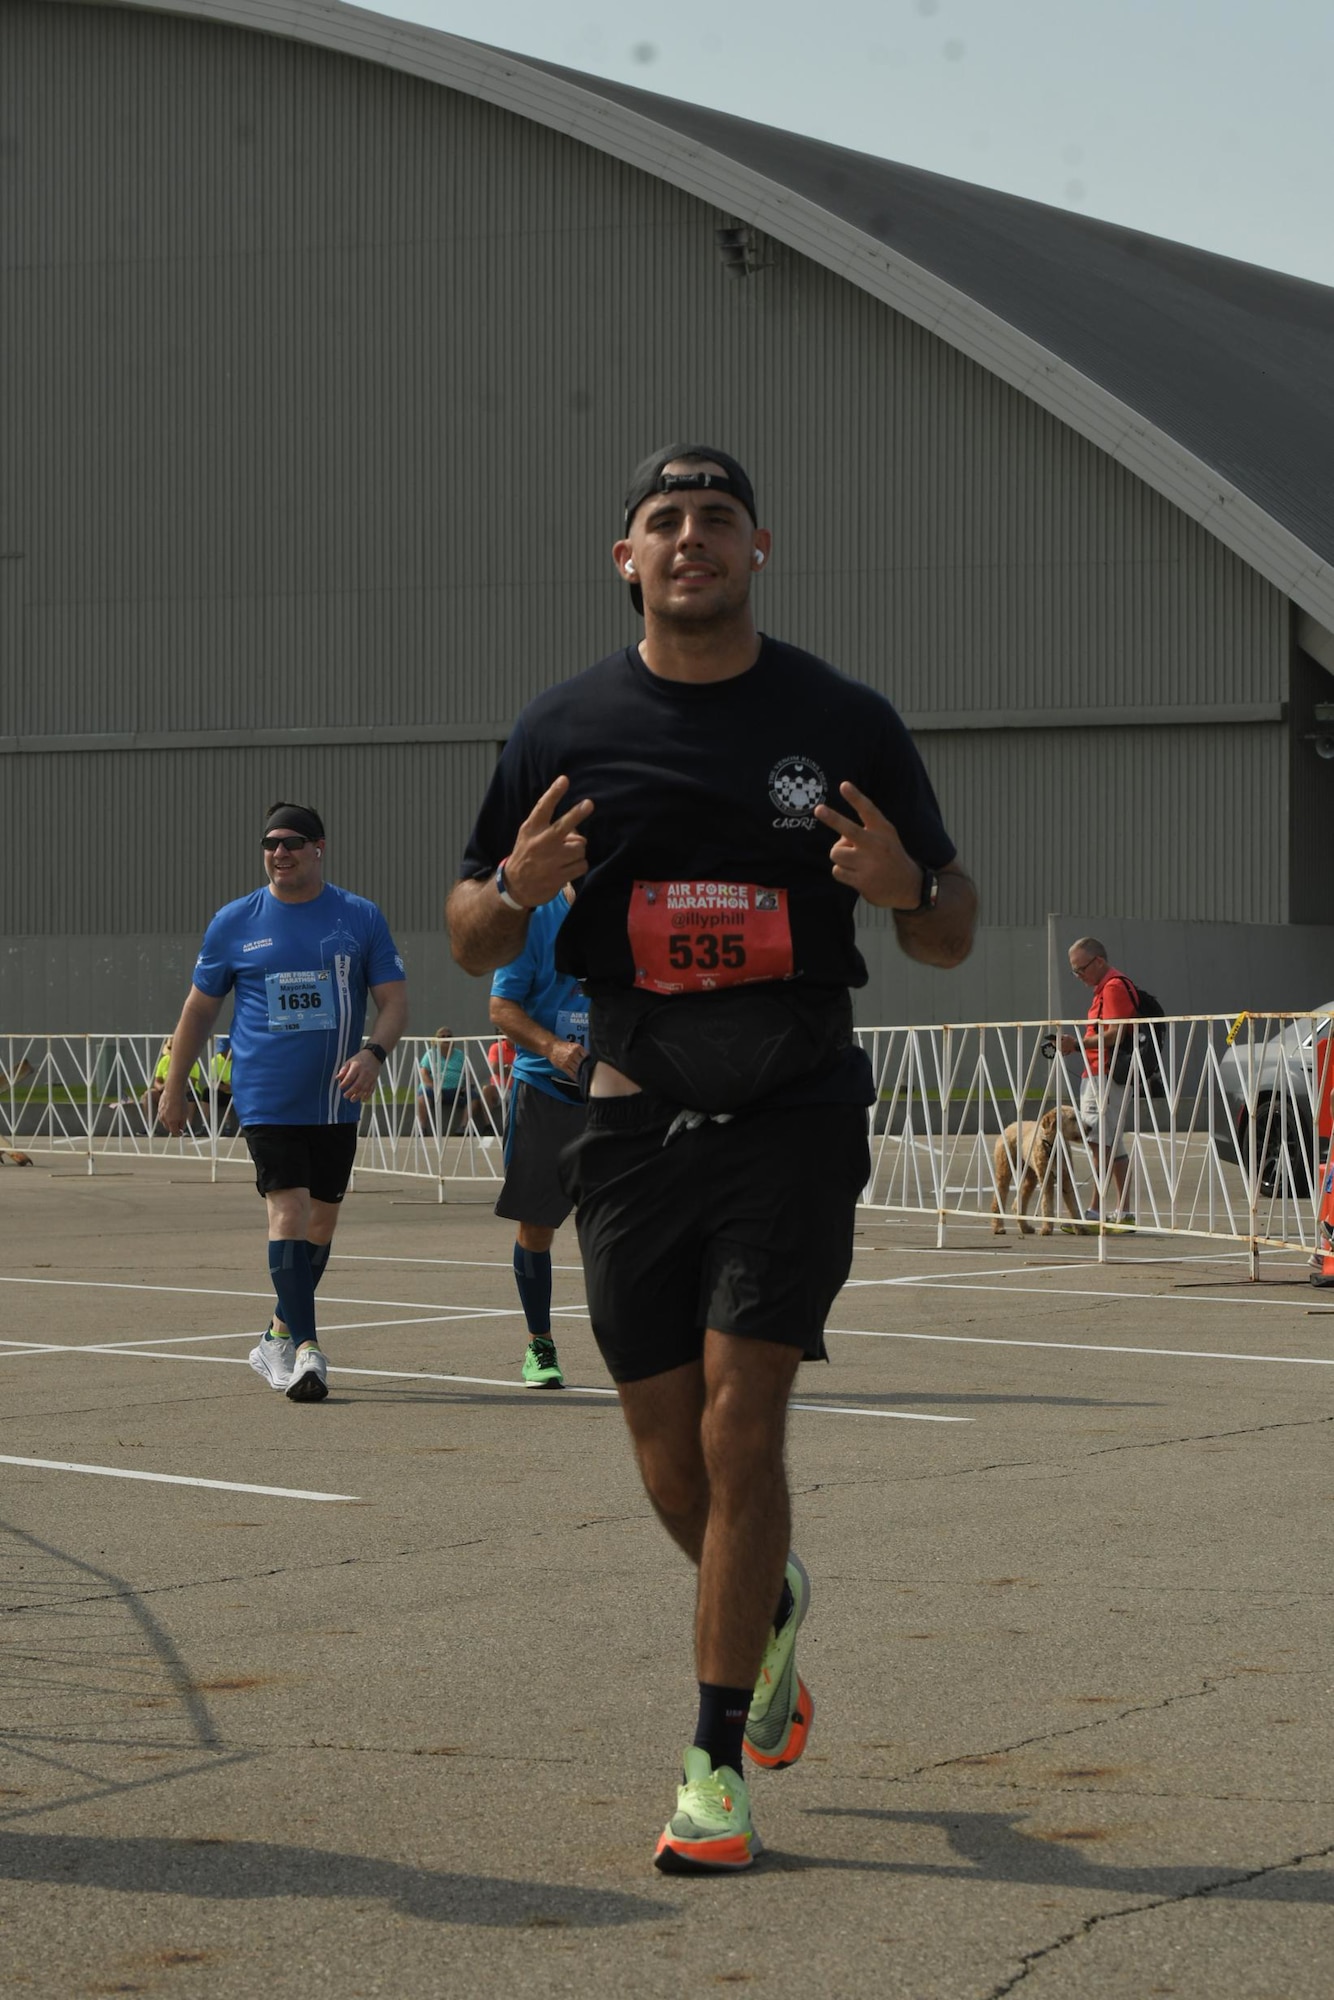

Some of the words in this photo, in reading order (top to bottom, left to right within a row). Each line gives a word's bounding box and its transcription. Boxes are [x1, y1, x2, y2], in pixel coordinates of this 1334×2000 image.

[667, 883, 691, 896] AIR
[696, 883, 748, 897] FORCE
[667, 896, 749, 909] MARATHON
[672, 912, 745, 928] @illyphill
[243, 943, 273, 953] MARATHON
[253, 938, 272, 946] FORCE
[669, 934, 746, 969] 535
[279, 976, 316, 984] MARATHON
[278, 992, 322, 1010] 1636
[567, 1034, 585, 1047] 21
